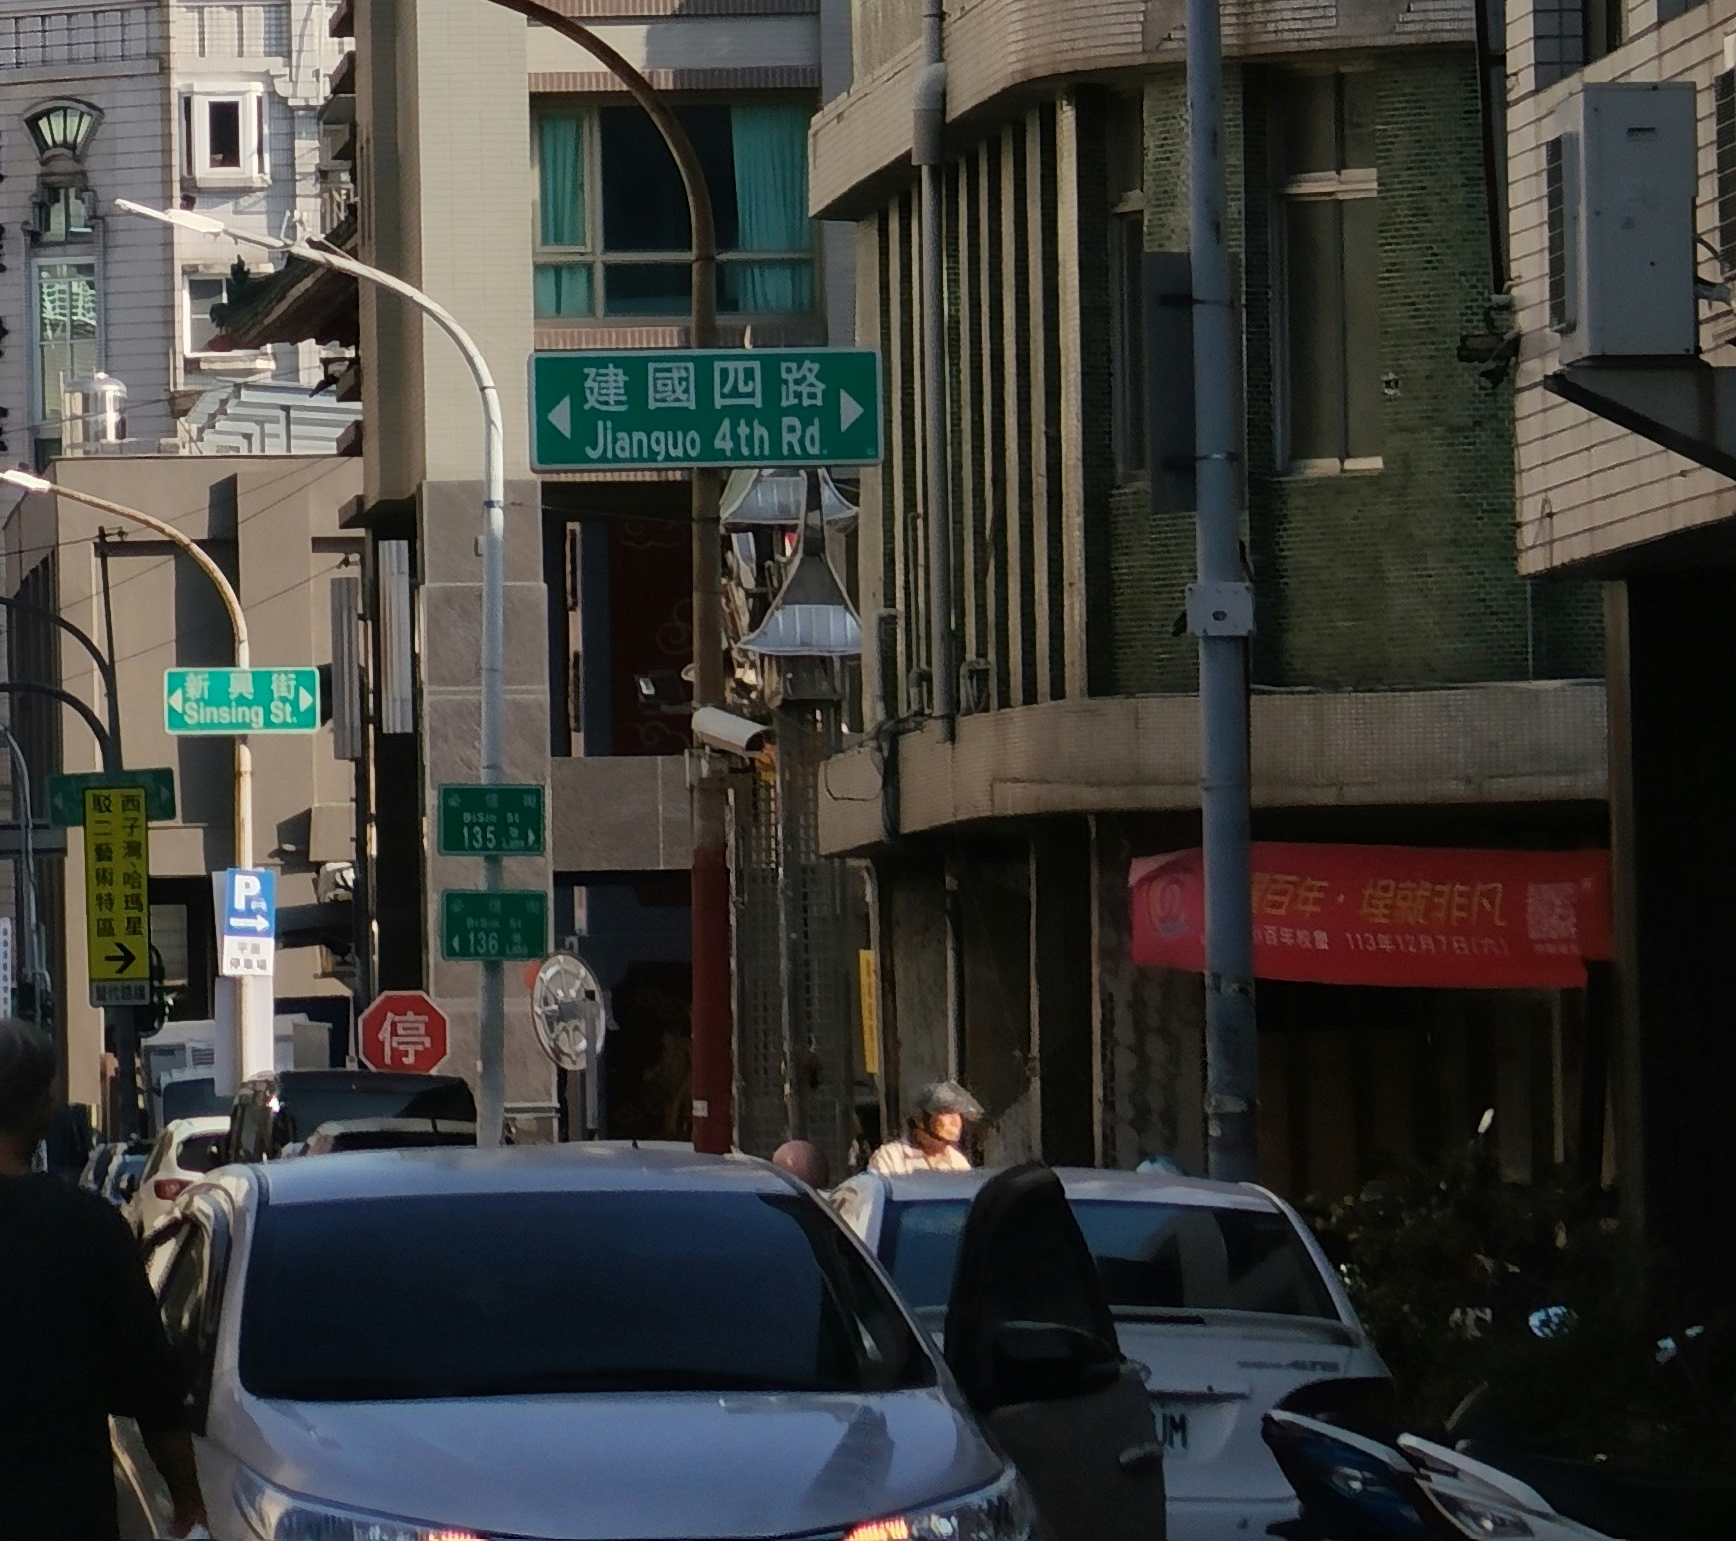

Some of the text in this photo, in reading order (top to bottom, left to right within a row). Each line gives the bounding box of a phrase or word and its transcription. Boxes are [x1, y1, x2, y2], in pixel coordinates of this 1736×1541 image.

[583, 359, 827, 411] 建國四路
[585, 416, 828, 461] Jianguo 4th Rd.
[184, 672, 296, 700] 新興街
[184, 700, 297, 728] Sinsing St.
[463, 825, 496, 849] 135
[92, 793, 116, 938] 駁二藝術特區
[234, 874, 261, 910] P
[469, 930, 499, 955] 136
[377, 1011, 432, 1066] 停
